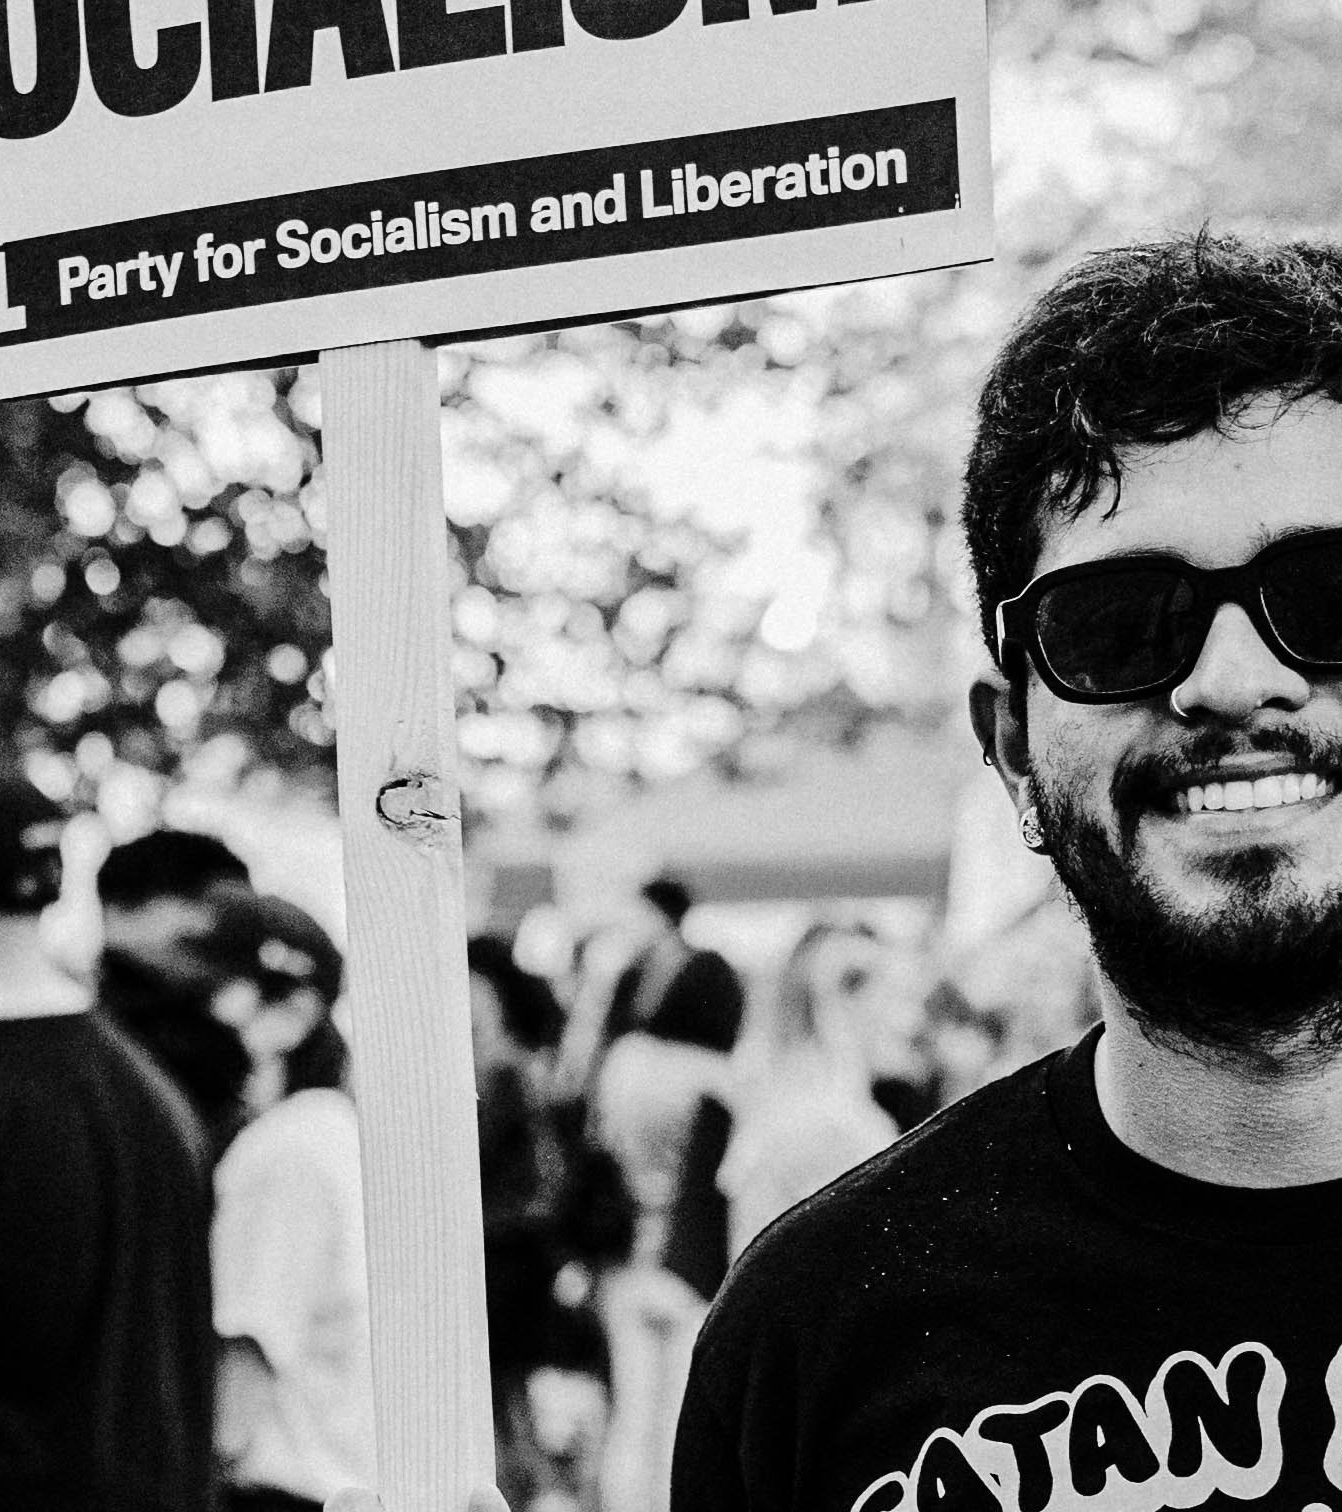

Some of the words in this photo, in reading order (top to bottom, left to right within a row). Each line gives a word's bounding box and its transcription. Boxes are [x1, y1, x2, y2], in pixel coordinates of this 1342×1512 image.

[59, 242, 183, 305] Party
[194, 231, 267, 282] for
[276, 201, 517, 269] Socialism
[531, 173, 628, 233] and
[640, 146, 908, 219] Liberation
